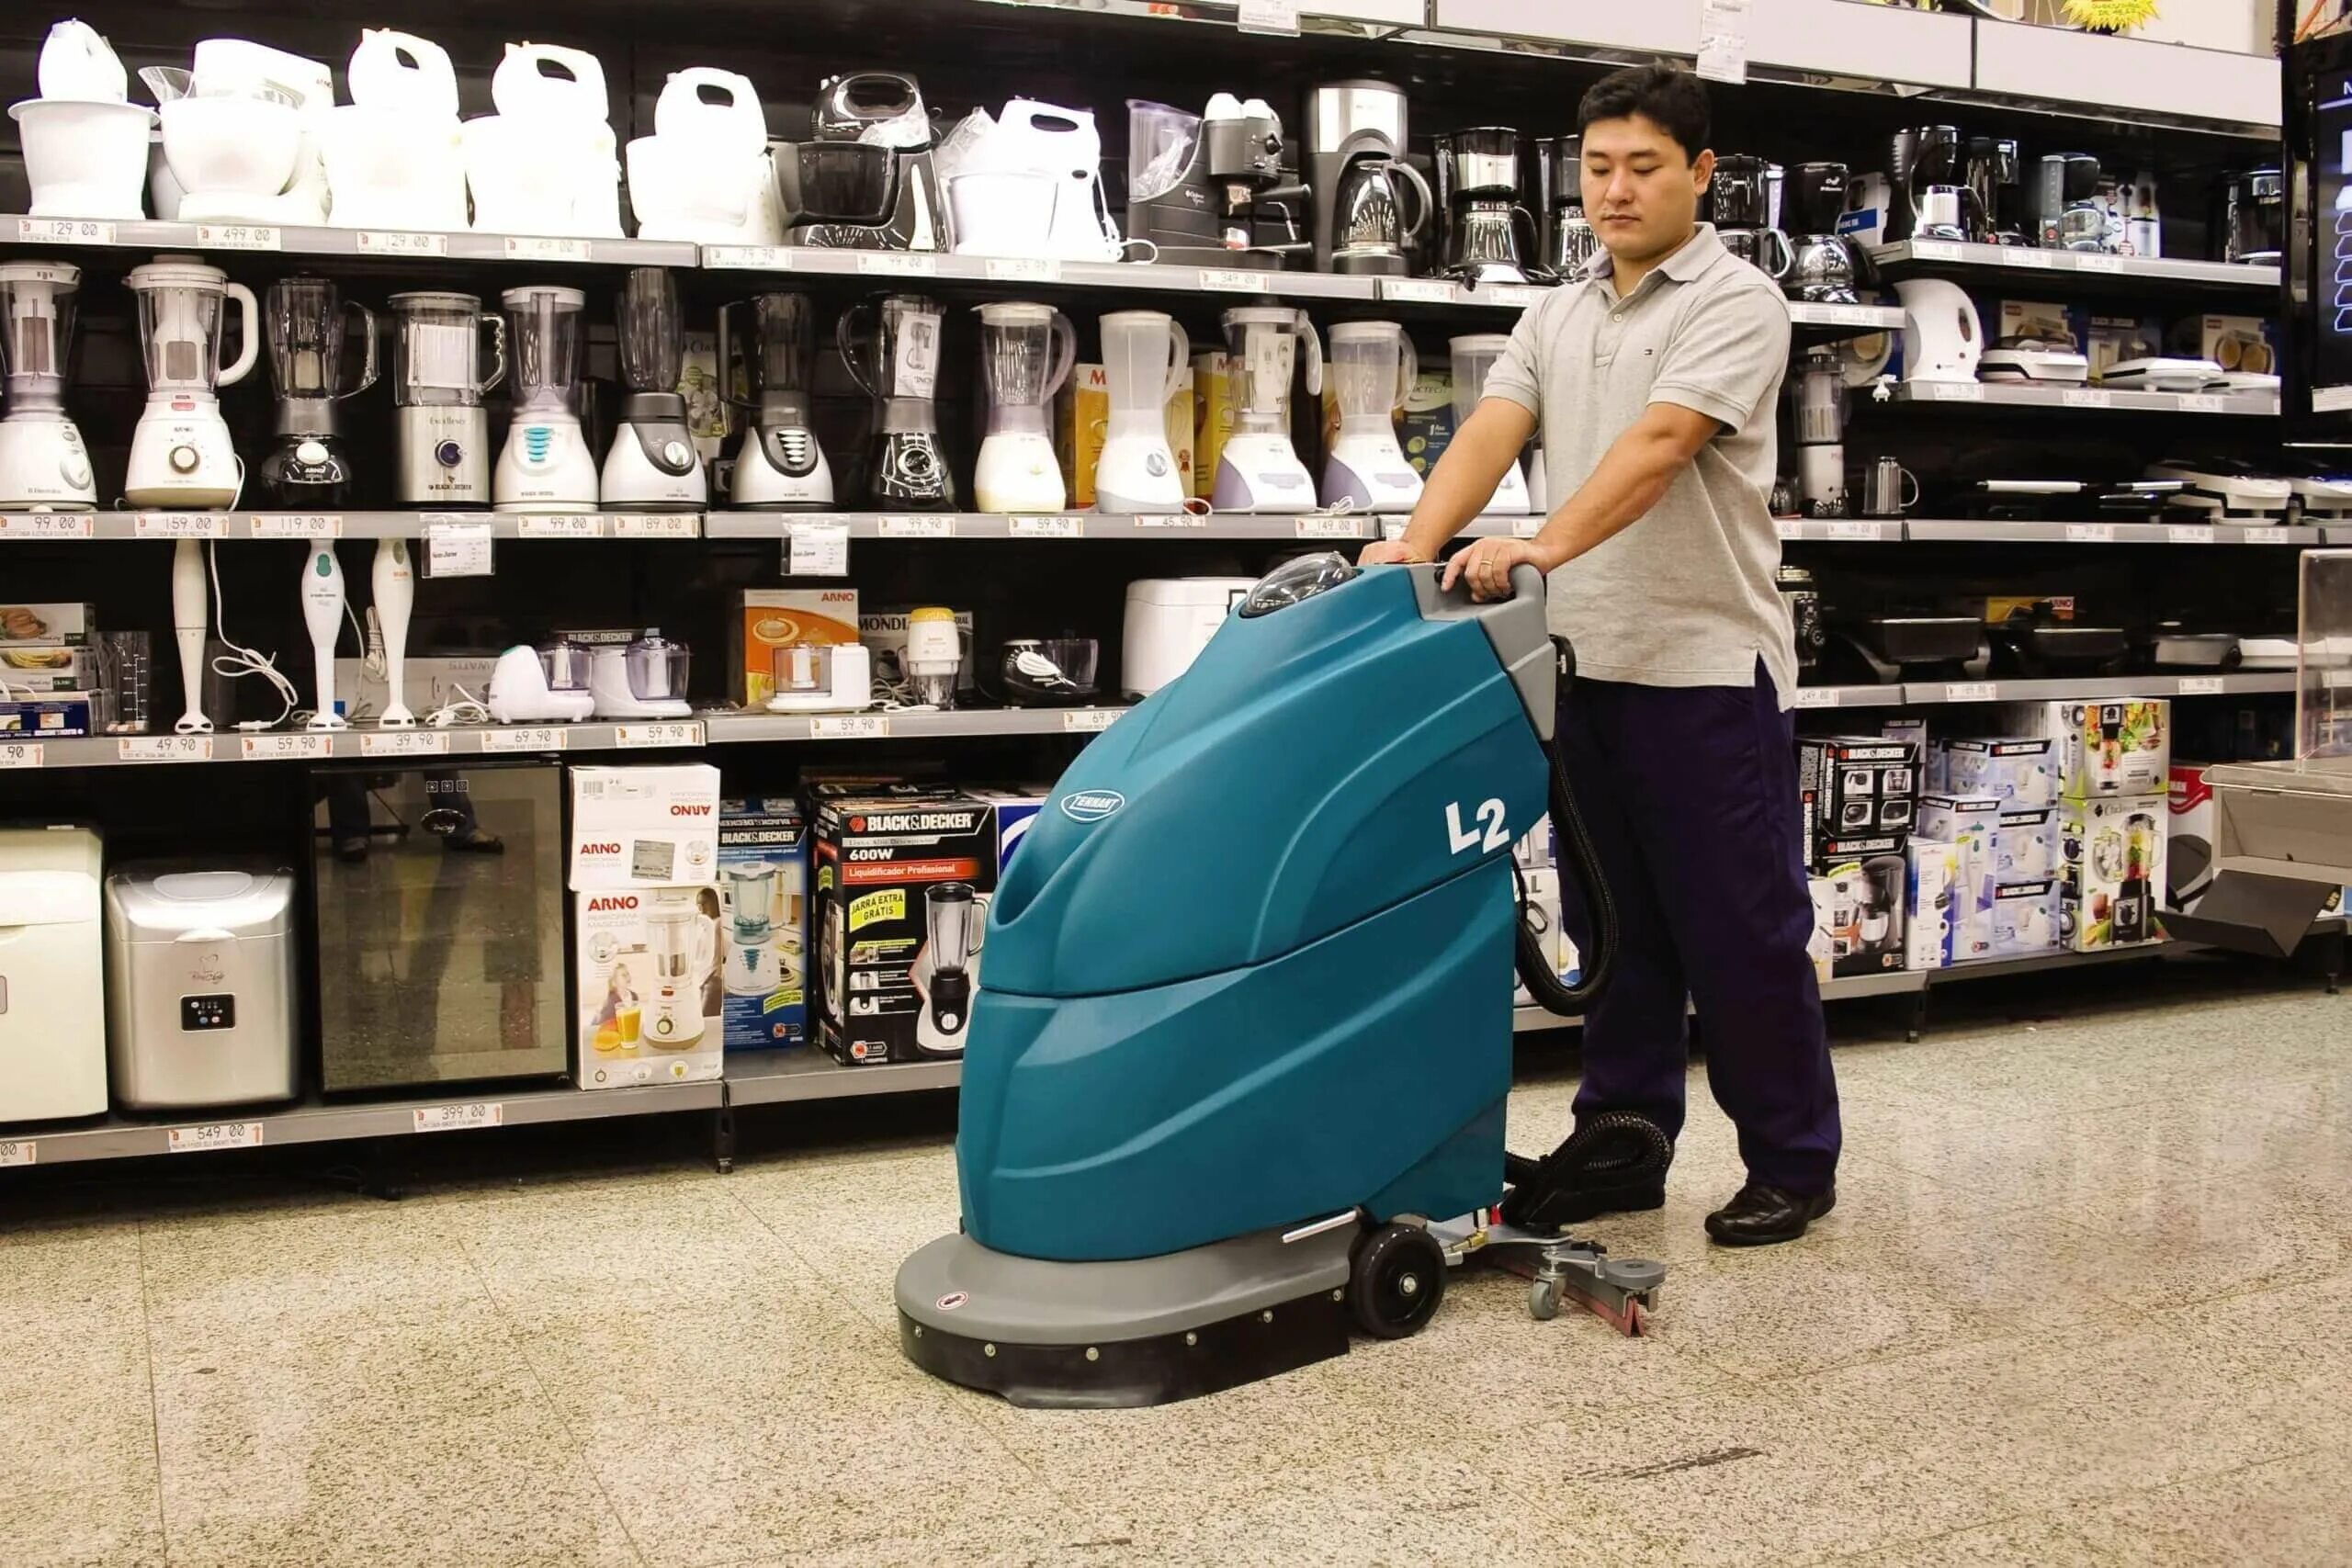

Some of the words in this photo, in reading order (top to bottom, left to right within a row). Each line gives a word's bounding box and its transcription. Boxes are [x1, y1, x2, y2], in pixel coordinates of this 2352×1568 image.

[51, 222, 98, 236] 129.00
[222, 228, 270, 242] 499.00
[386, 234, 429, 248] 129.00
[35, 516, 75, 530] 99.00
[164, 516, 211, 530] 159.00
[280, 516, 325, 530] 119.00
[550, 516, 587, 529] 99.00
[640, 516, 682, 530] 189.00
[909, 517, 942, 529] 99.90
[1037, 518, 1069, 530] 59.90
[1162, 516, 1193, 528] 45.90
[1317, 519, 1351, 531] 149.00
[821, 592, 854, 603] ARNO
[858, 616, 910, 631] MONDI
[842, 718, 875, 731] 59.90
[514, 730, 551, 743] 69.90
[649, 726, 684, 739] 59.90
[156, 738, 196, 751] 49.90
[277, 737, 316, 750] 59.90
[397, 733, 434, 747] 39.90
[671, 805, 712, 816] ARNO
[867, 814, 974, 832] BLACK&DECKER
[1445, 797, 1510, 855] L2
[721, 830, 796, 844] BLACK&DECKER
[580, 843, 621, 855] ARNO
[849, 849, 894, 861] 600W
[849, 866, 906, 879] Liquidificador
[908, 863, 956, 876] Profissional
[587, 897, 639, 912] ARNO
[852, 899, 877, 915] JARRA
[878, 893, 904, 905] EXTRA
[863, 906, 895, 921] GRÁTIS
[441, 1105, 486, 1121] 399.00
[197, 1123, 244, 1140] 549.00
